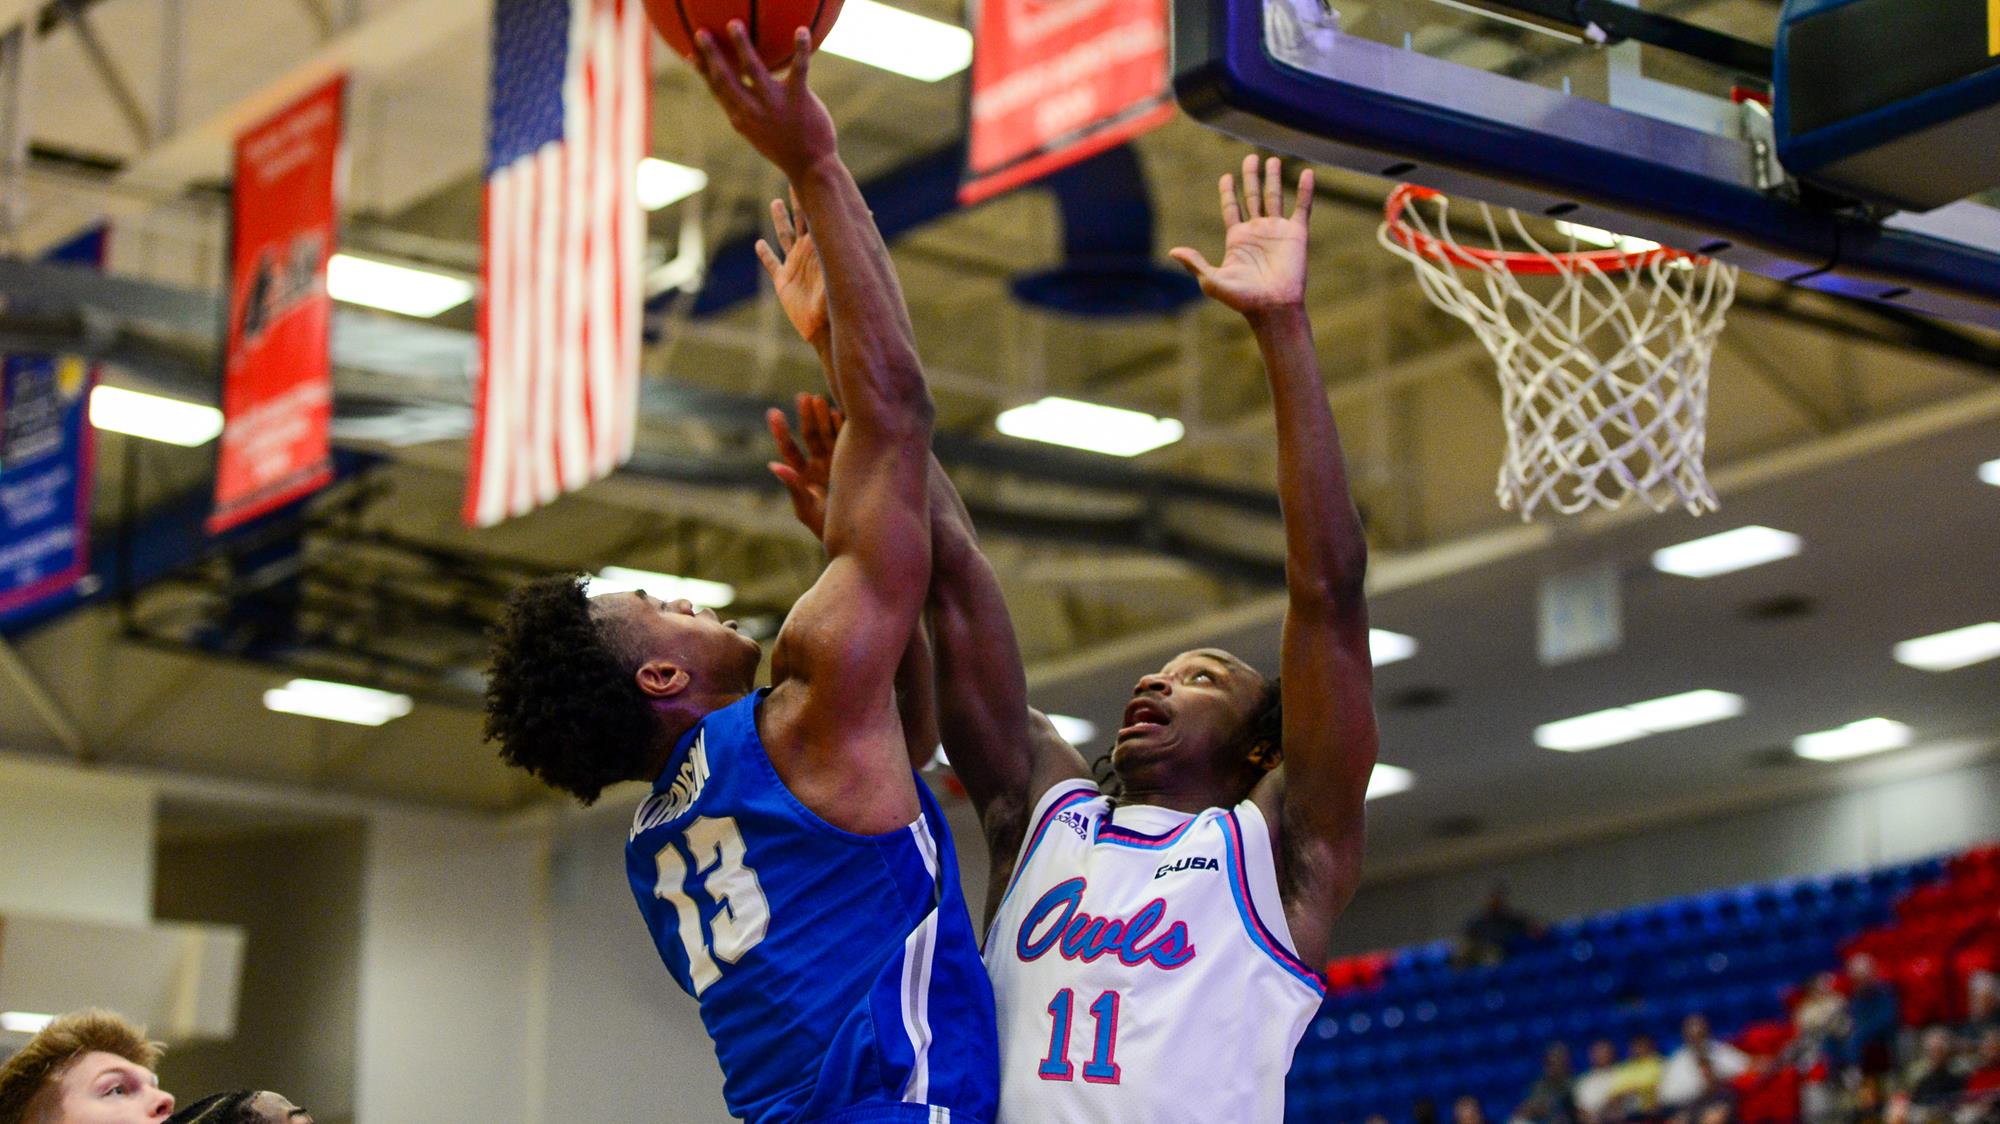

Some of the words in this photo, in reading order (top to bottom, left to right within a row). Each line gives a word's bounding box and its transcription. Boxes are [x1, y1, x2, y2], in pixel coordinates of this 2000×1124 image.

[655, 815, 771, 996] 13
[1017, 876, 1196, 970] Owls
[1038, 988, 1121, 1084] 11
